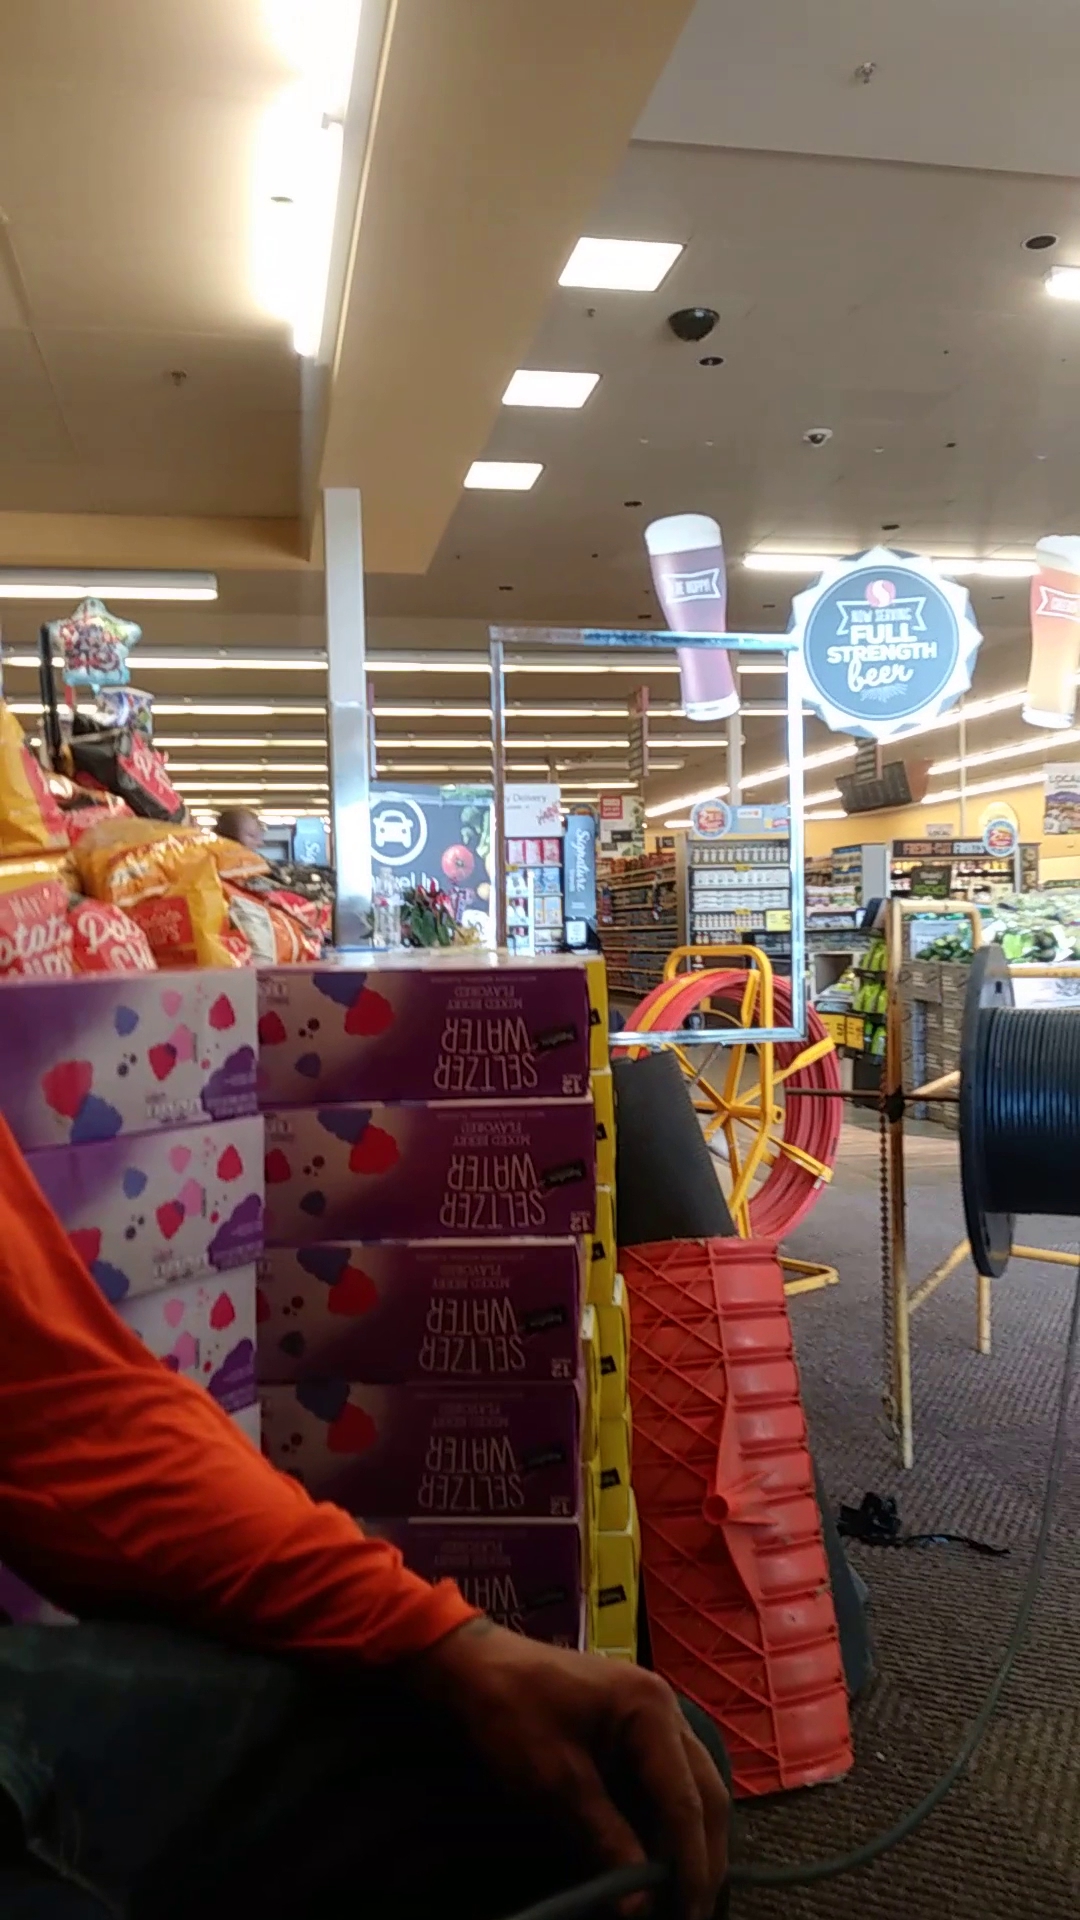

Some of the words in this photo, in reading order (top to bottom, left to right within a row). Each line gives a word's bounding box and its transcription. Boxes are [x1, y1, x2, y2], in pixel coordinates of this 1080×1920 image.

[827, 642, 937, 664] STRENGTH
[850, 623, 918, 645] FULL
[847, 664, 914, 693] beer
[441, 1016, 532, 1054] WATER
[433, 1052, 538, 1091] SELTZER
[447, 1153, 539, 1191] WATER
[439, 1190, 546, 1230] SELTZER
[425, 1296, 518, 1336] WATER
[418, 1335, 527, 1374] SELTZER
[425, 1435, 518, 1474] WATER
[417, 1473, 526, 1511] SELTZER
